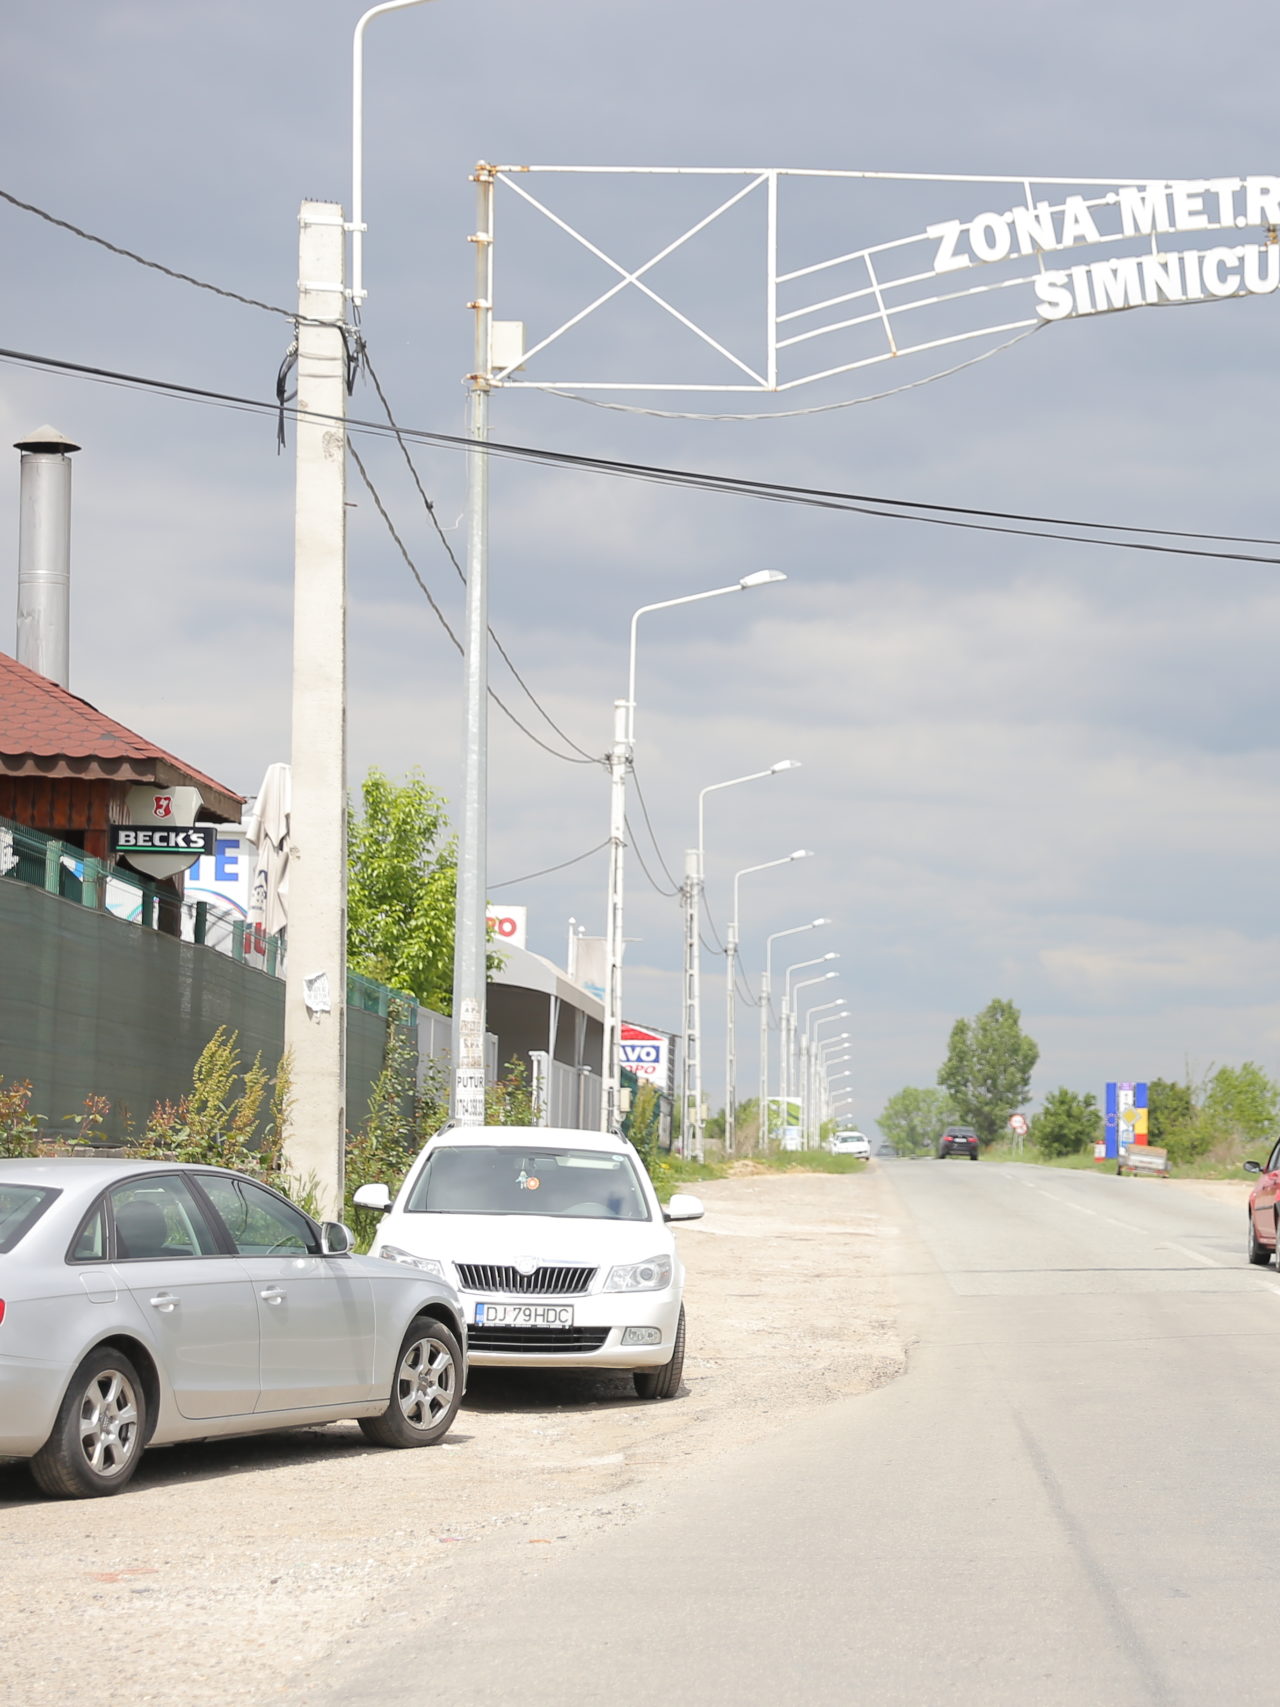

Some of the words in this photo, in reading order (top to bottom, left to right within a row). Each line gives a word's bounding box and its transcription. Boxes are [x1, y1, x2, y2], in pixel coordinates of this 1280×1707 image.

[926, 195, 1101, 274] ZONA
[1034, 244, 1280, 320] SIMNICU
[118, 829, 205, 848] BECK'S
[487, 1306, 507, 1321] DJ
